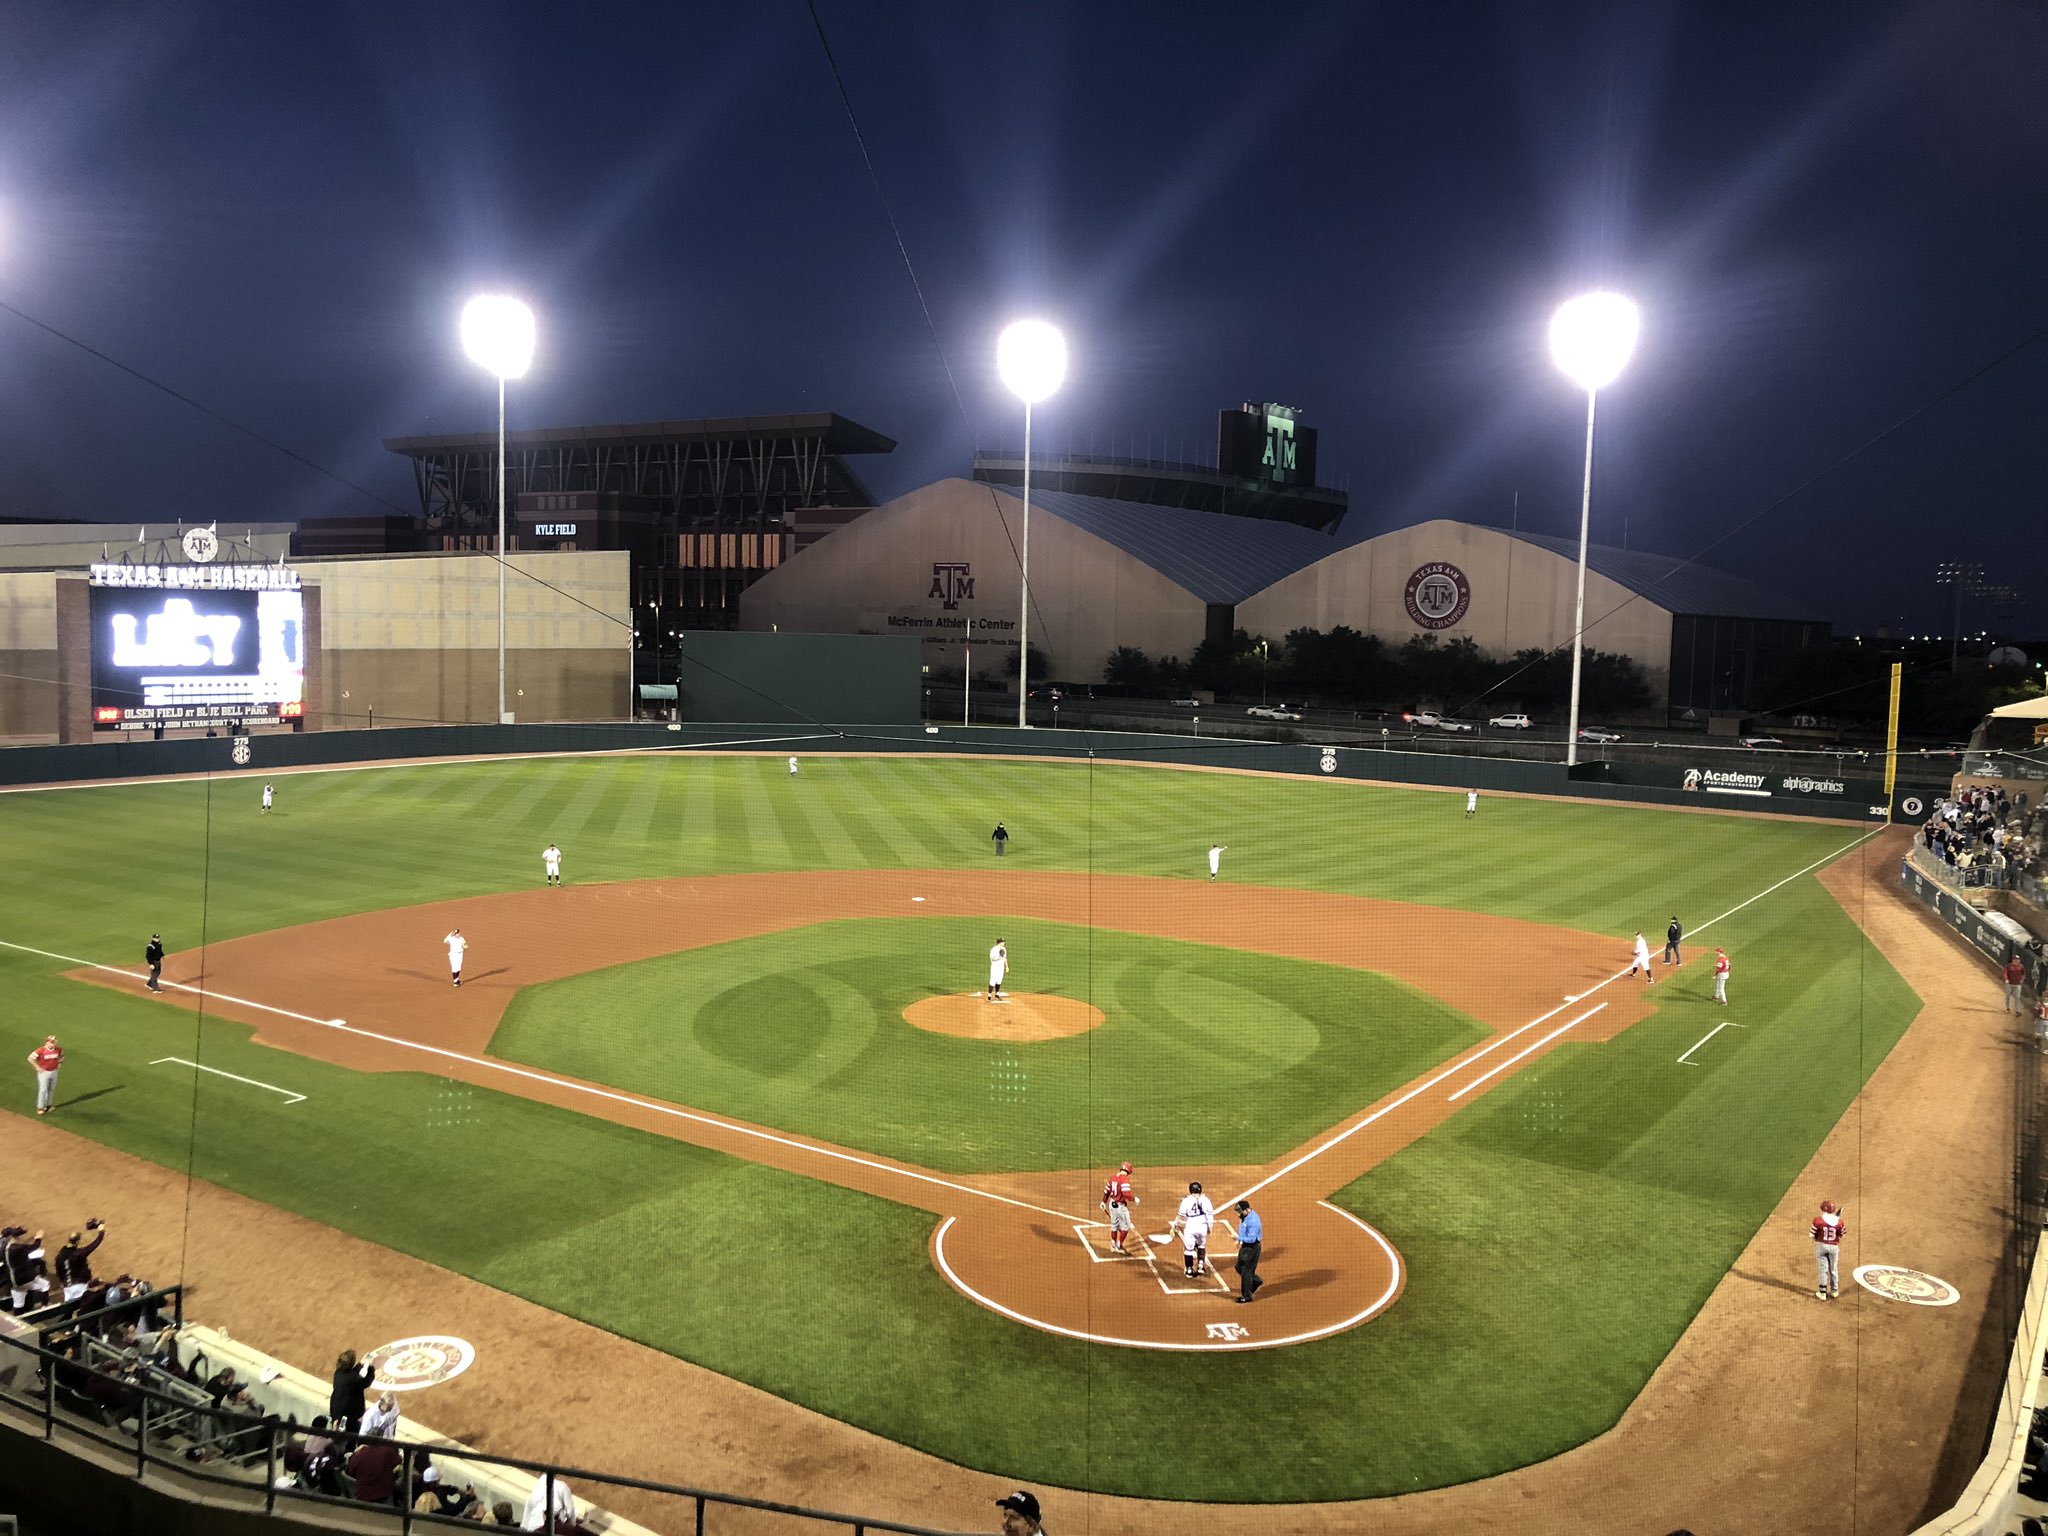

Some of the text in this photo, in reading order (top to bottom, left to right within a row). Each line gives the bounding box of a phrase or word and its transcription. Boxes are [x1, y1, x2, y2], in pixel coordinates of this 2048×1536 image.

[535, 524, 577, 536] KYLE FIELD
[91, 564, 301, 590] TEXAS A&M BASEBALL
[1415, 565, 1443, 580] TEXAS
[1406, 596, 1469, 628] BUILDING CHAMPIONS
[887, 616, 1016, 630] McFerrin Athletc Center
[124, 708, 154, 719] OLSEN
[156, 707, 184, 718] FIELD
[185, 709, 195, 717] AT
[221, 706, 243, 716] BELL
[245, 705, 268, 715] PARK
[925, 726, 939, 734] 400
[234, 737, 249, 746] 375
[233, 746, 250, 763] SEC
[1321, 748, 1336, 756] 375
[1321, 756, 1336, 771] SEC
[1703, 769, 1765, 787] Academy
[1782, 776, 1844, 793] alphagraphics
[1869, 806, 1889, 815] 330
[1822, 1226, 1837, 1241] 13
